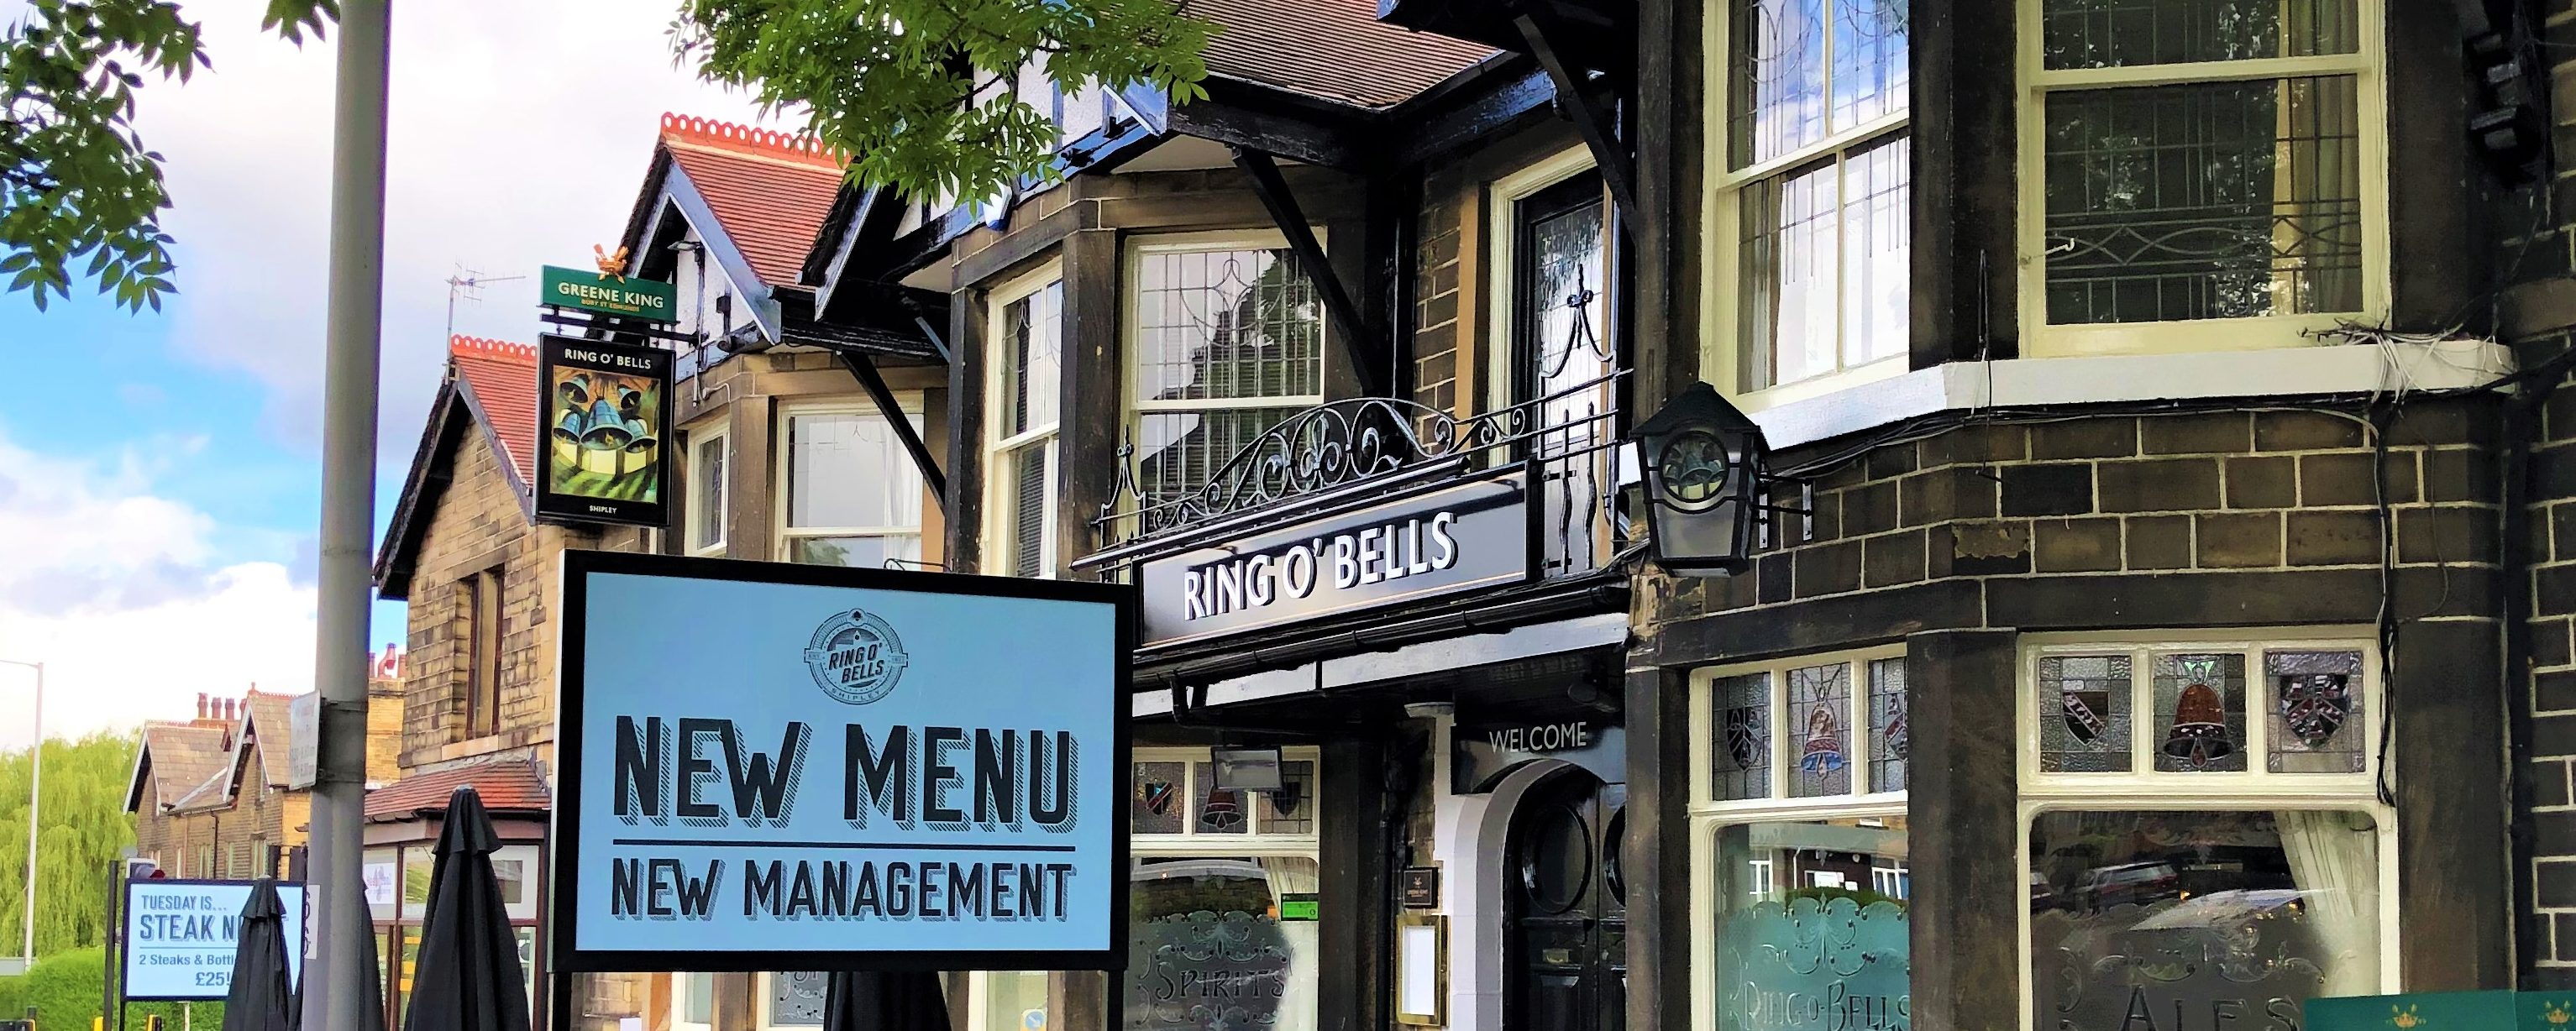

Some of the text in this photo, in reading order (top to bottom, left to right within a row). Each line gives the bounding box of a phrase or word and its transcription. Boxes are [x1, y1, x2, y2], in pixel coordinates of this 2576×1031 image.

[558, 282, 664, 308] GREENE KING
[564, 348, 651, 369] RING O' BELLS
[589, 505, 617, 514] SHIPLEY
[1183, 511, 1458, 620] RING O' BELLS
[828, 646, 865, 671] RING
[867, 641, 883, 662] O'
[841, 659, 884, 683] BELLS
[832, 688, 880, 700] SHIPLEY
[1488, 721, 1587, 753] WELCOME
[613, 715, 1078, 834] NEW MENU
[141, 894, 197, 910] TUESDAY
[610, 857, 1077, 924] NEW MANAGEMENT
[139, 913, 215, 942] STEAK
[139, 954, 234, 966] 2 Steaks & Bottl
[195, 971, 230, 987] £25!
[1155, 961, 1287, 1003] SPIRITS
